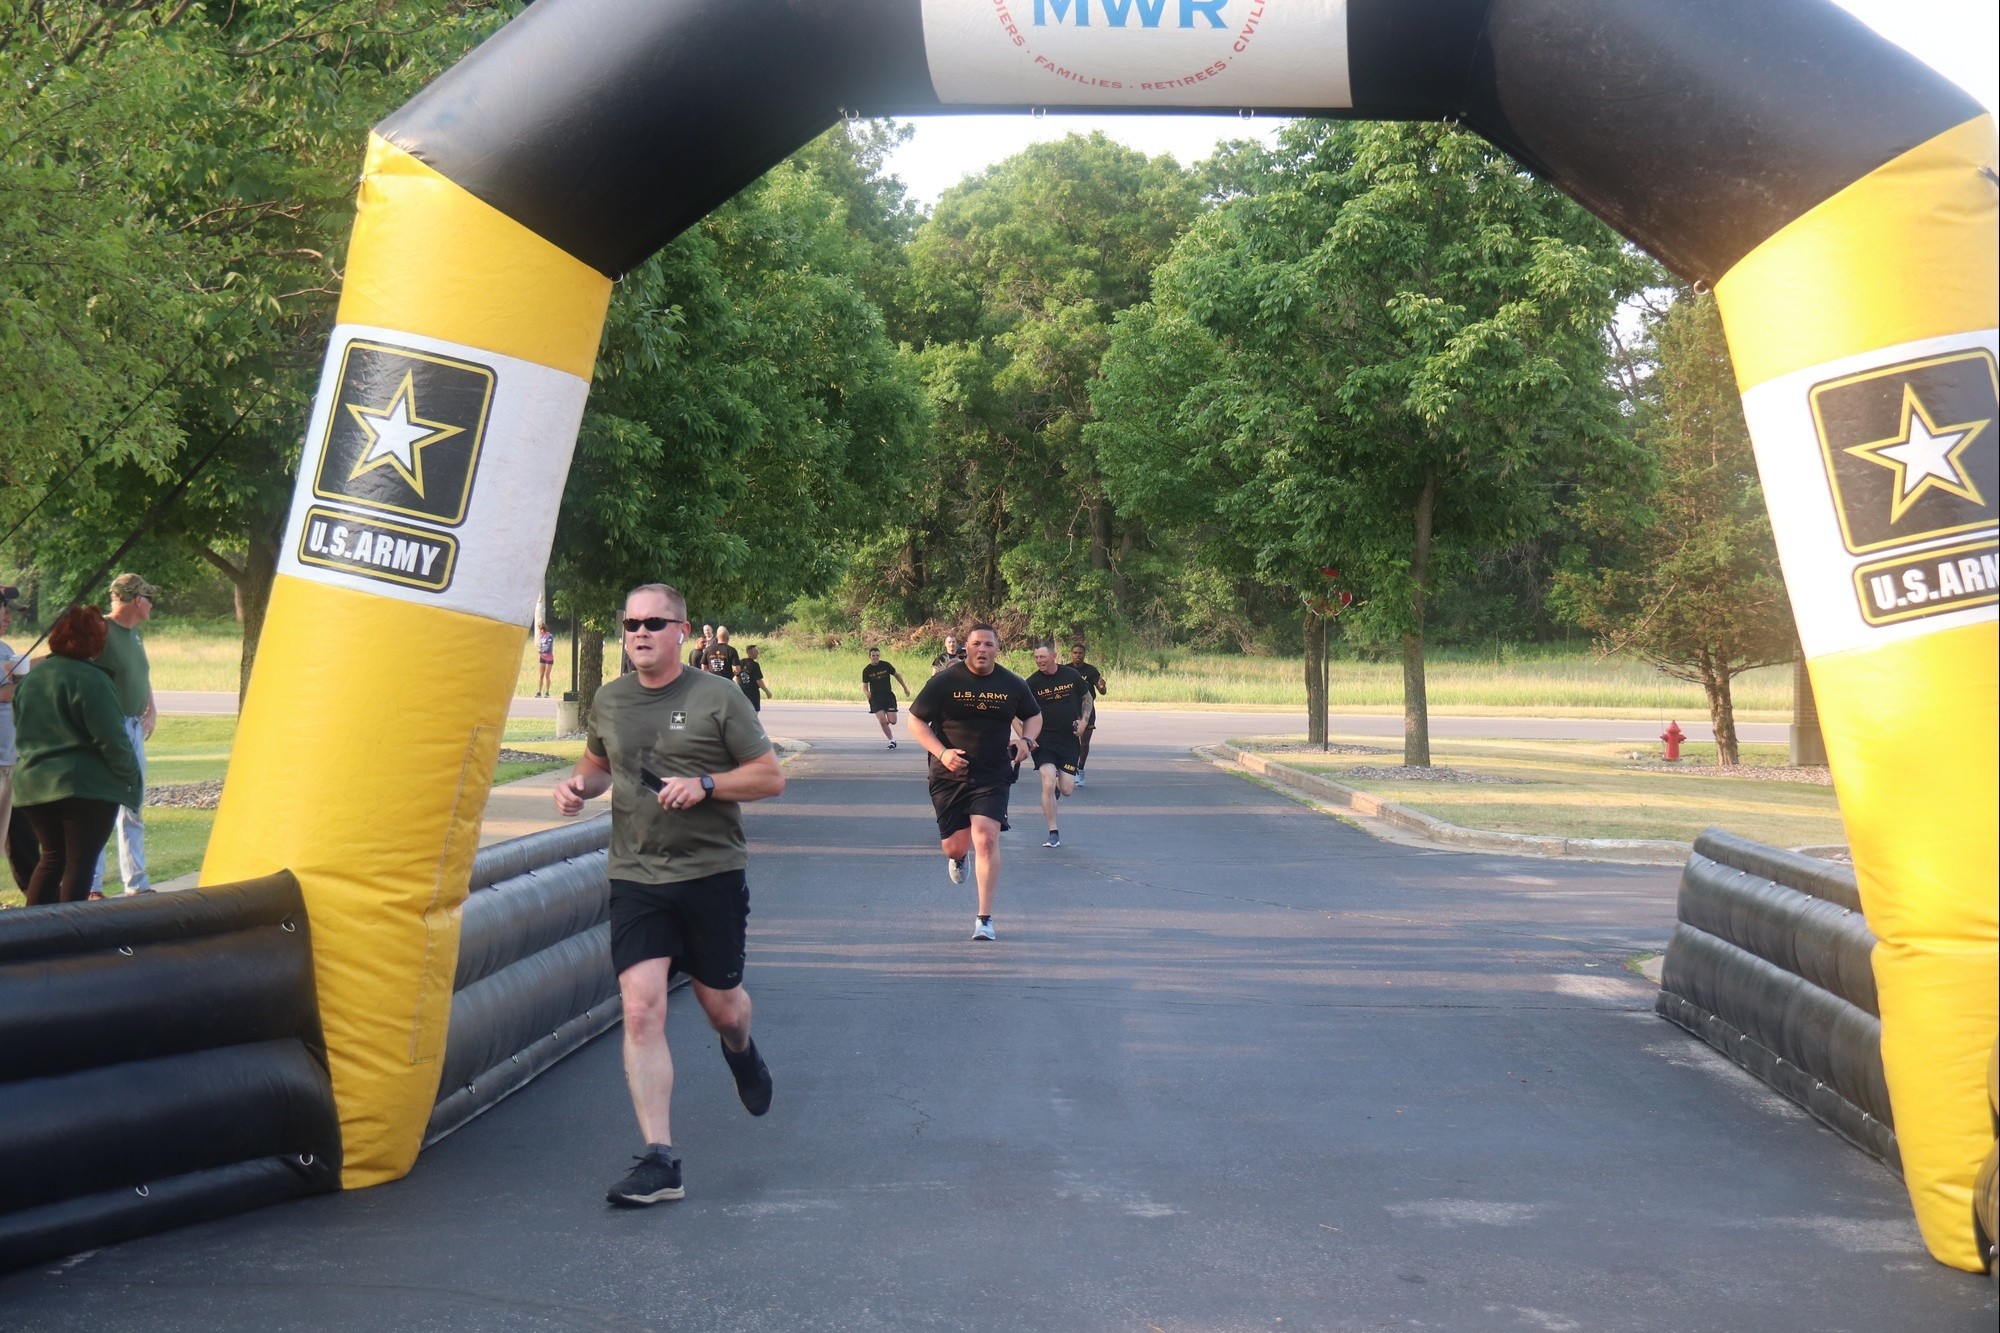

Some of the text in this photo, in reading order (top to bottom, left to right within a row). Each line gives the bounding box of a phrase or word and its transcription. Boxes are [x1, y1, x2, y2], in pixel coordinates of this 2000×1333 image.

[1032, 0, 1229, 29] MWR
[1034, 54, 1123, 89] FAMILIES
[1141, 60, 1227, 90] RETIREES
[309, 521, 441, 576] U.S.ARMY
[978, 692, 1008, 700] ARMY
[1053, 683, 1074, 692] ARMY
